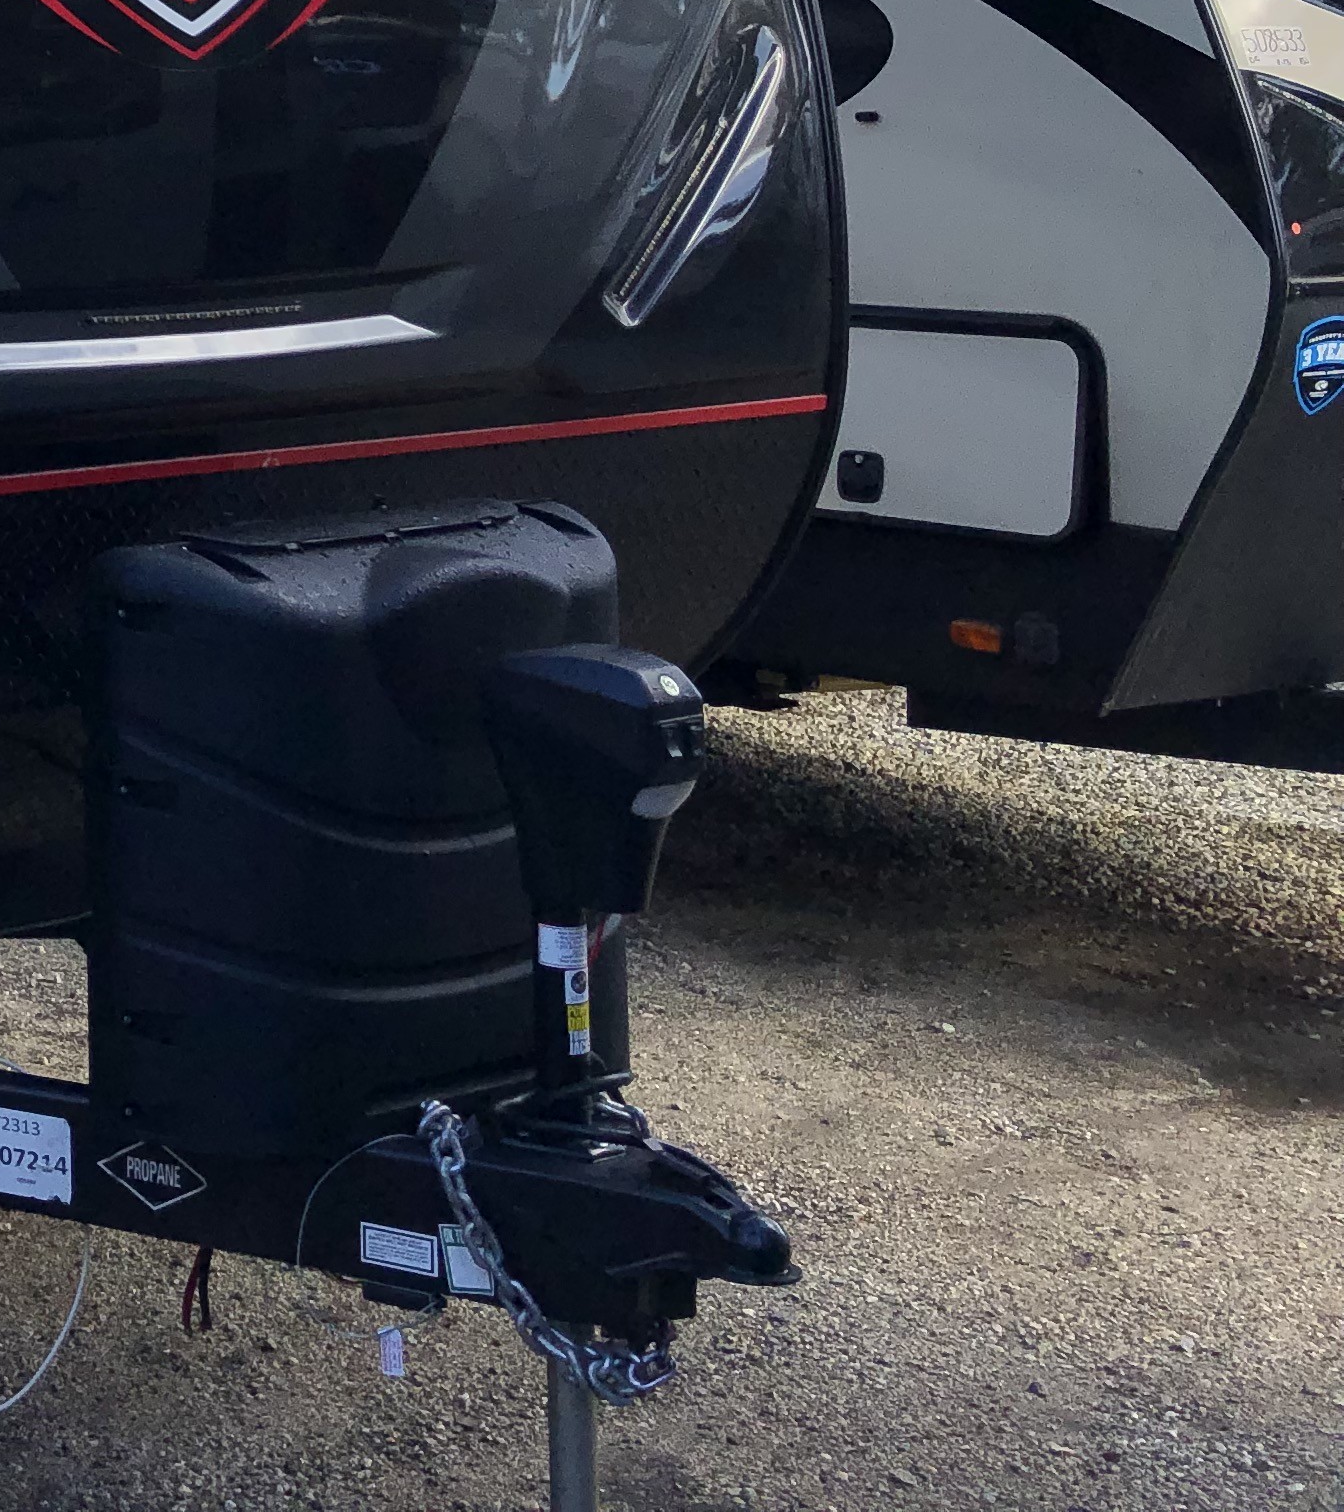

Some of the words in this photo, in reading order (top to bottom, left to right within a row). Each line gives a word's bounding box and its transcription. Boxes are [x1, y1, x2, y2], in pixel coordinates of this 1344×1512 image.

[1241, 28, 1306, 53] 508533
[1302, 348, 1312, 367] 3
[126, 1155, 181, 1189] PROPANE
